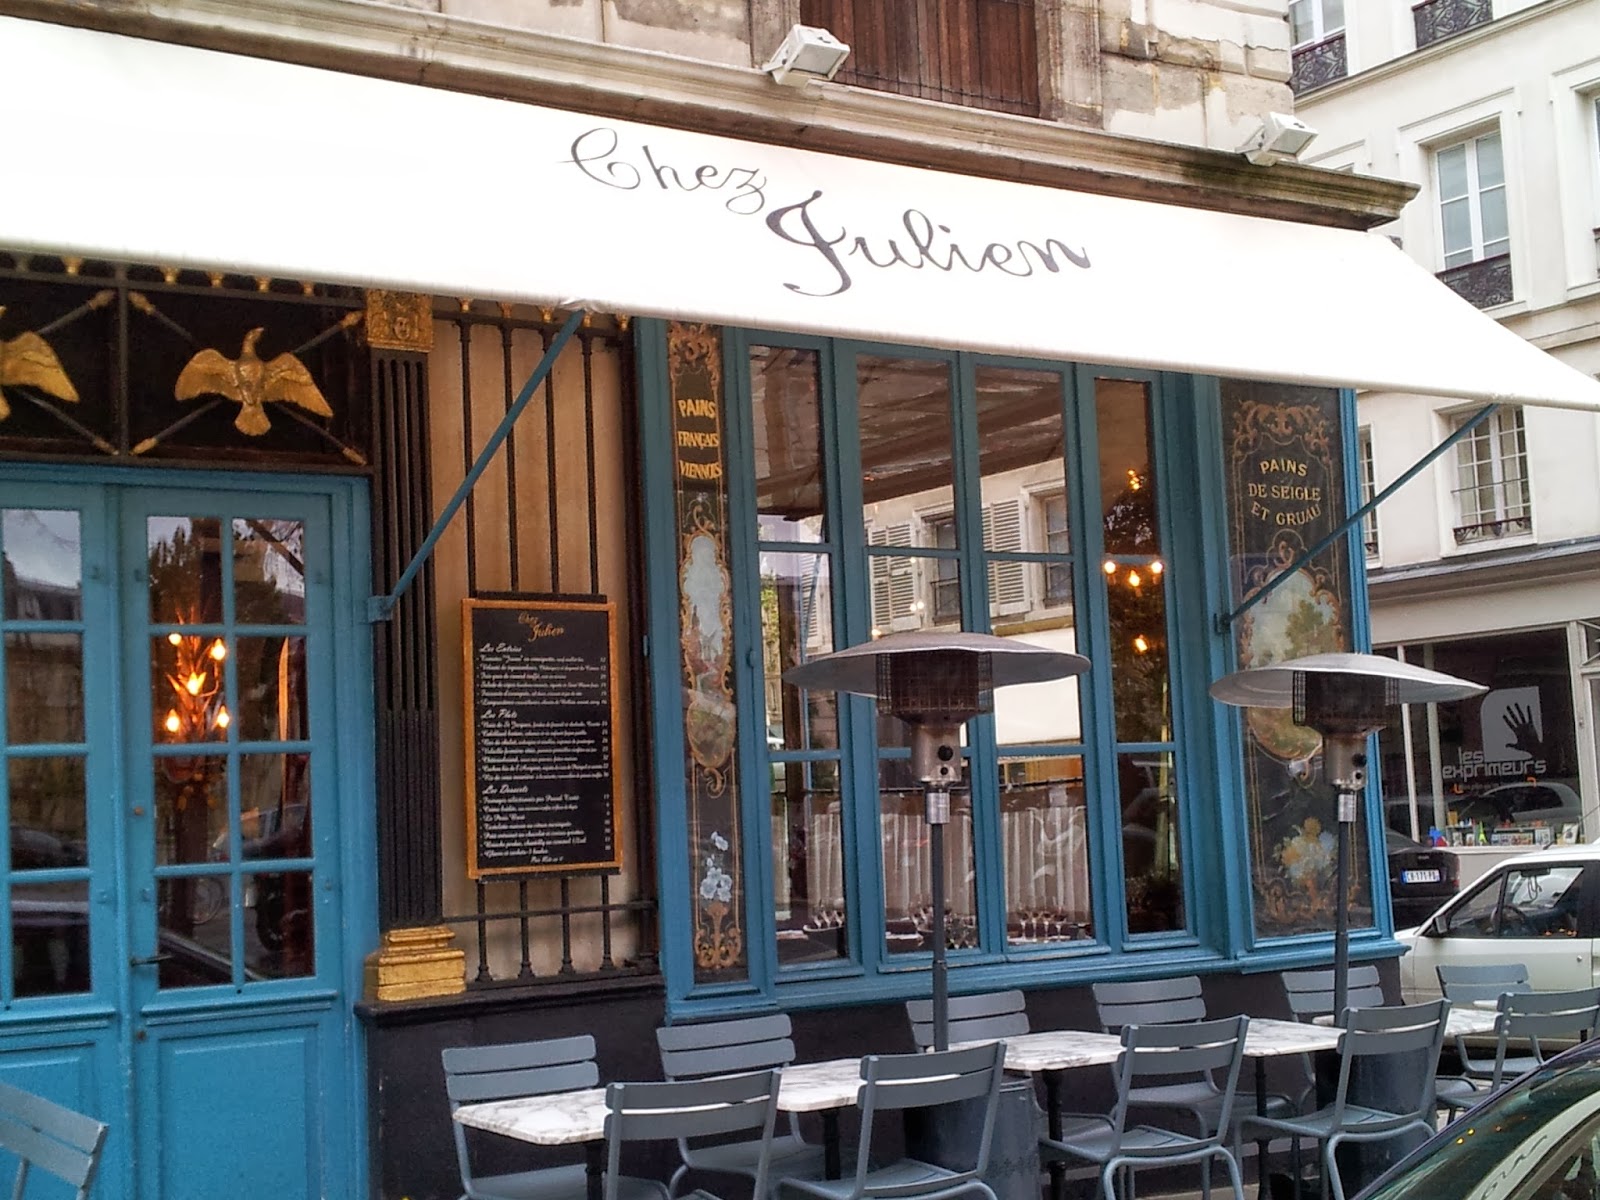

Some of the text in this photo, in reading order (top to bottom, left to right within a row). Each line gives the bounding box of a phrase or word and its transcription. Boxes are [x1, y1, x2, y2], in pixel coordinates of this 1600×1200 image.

[556, 127, 767, 215] Chez
[765, 190, 1092, 297] Julien
[678, 399, 716, 419] PAINS
[678, 431, 719, 450] FRANÇAIS
[680, 460, 723, 480] VIENNOIS
[1259, 458, 1308, 477] PAINS
[1248, 483, 1321, 501] DE SEIGLE
[1250, 501, 1322, 526] ET GRUAU
[527, 622, 564, 642] Julien
[1458, 746, 1485, 764] les
[1442, 758, 1547, 782] exprimeurs
